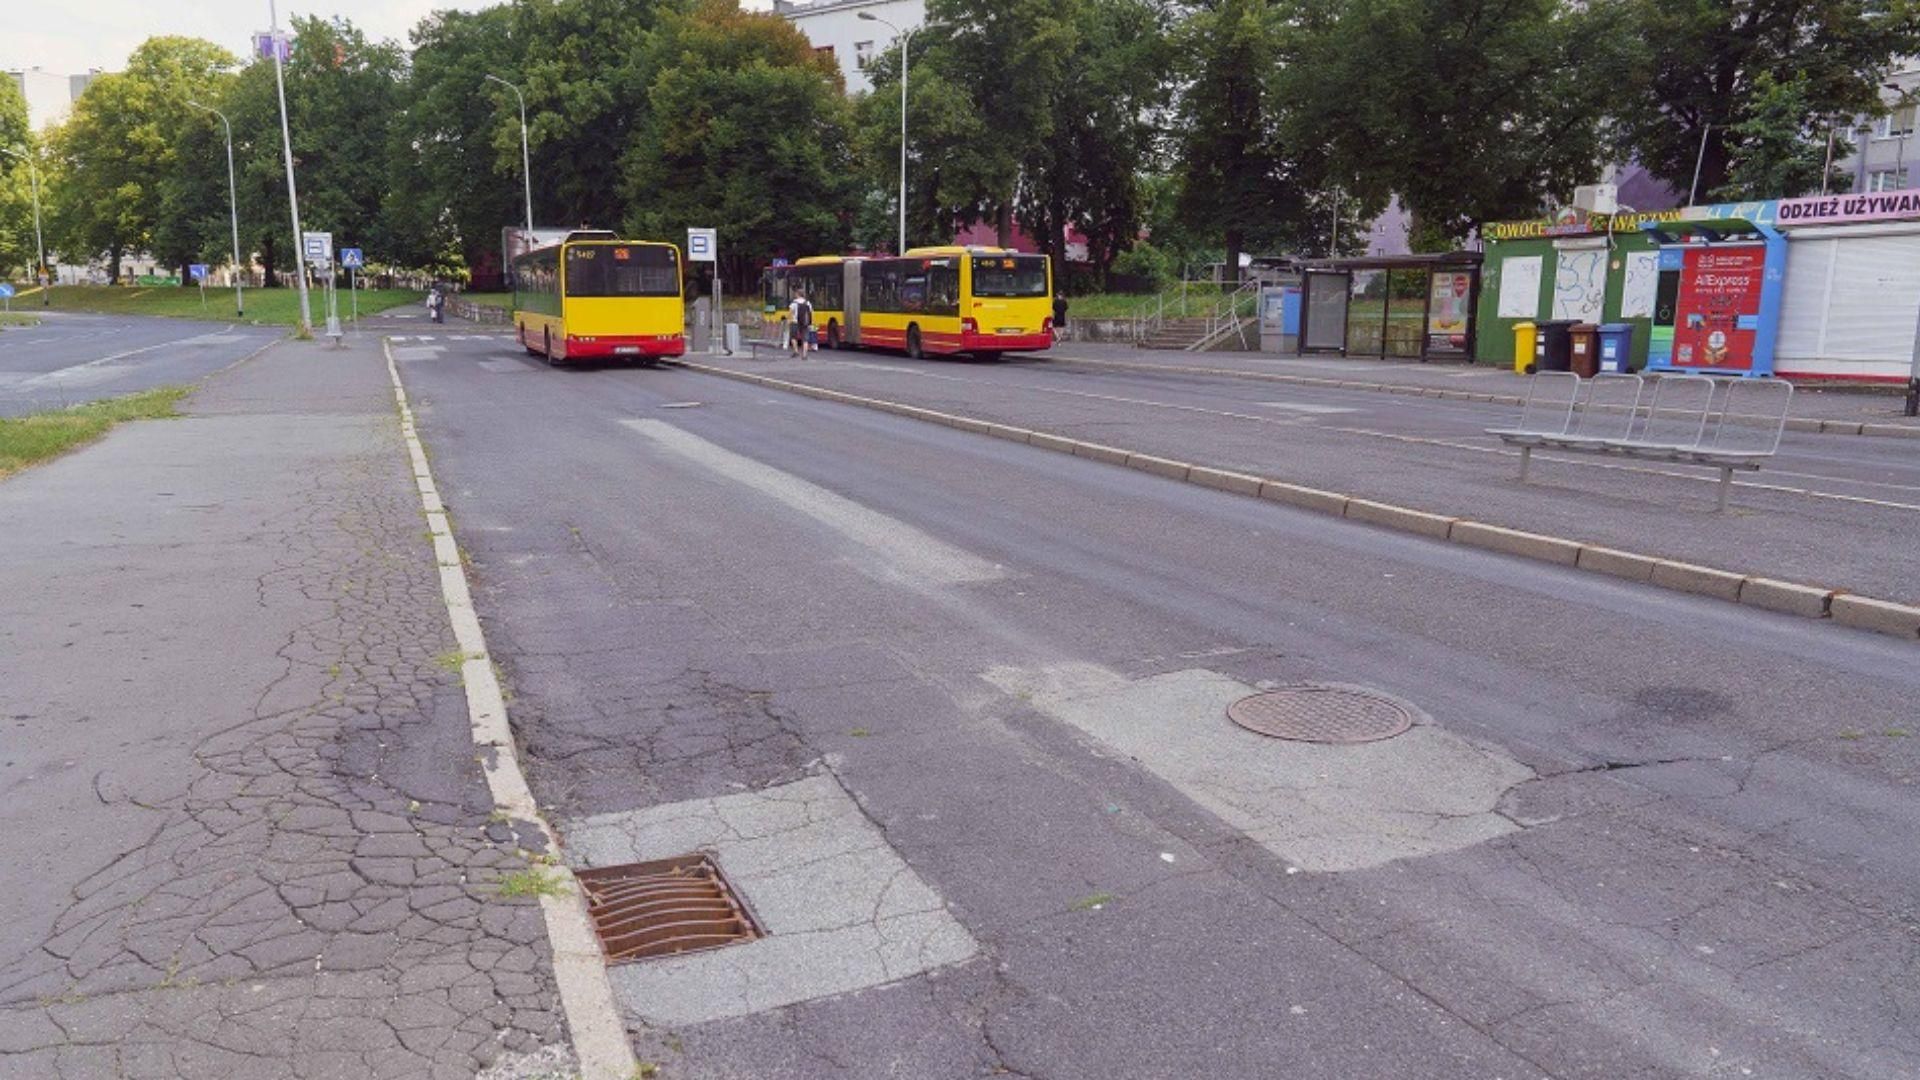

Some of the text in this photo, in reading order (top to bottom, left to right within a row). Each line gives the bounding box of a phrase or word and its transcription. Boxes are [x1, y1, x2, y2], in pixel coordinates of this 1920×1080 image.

[1780, 198, 1839, 219] ODZIEŻ
[1496, 221, 1545, 237] OWOCE
[1694, 274, 1750, 288] AliExpress
